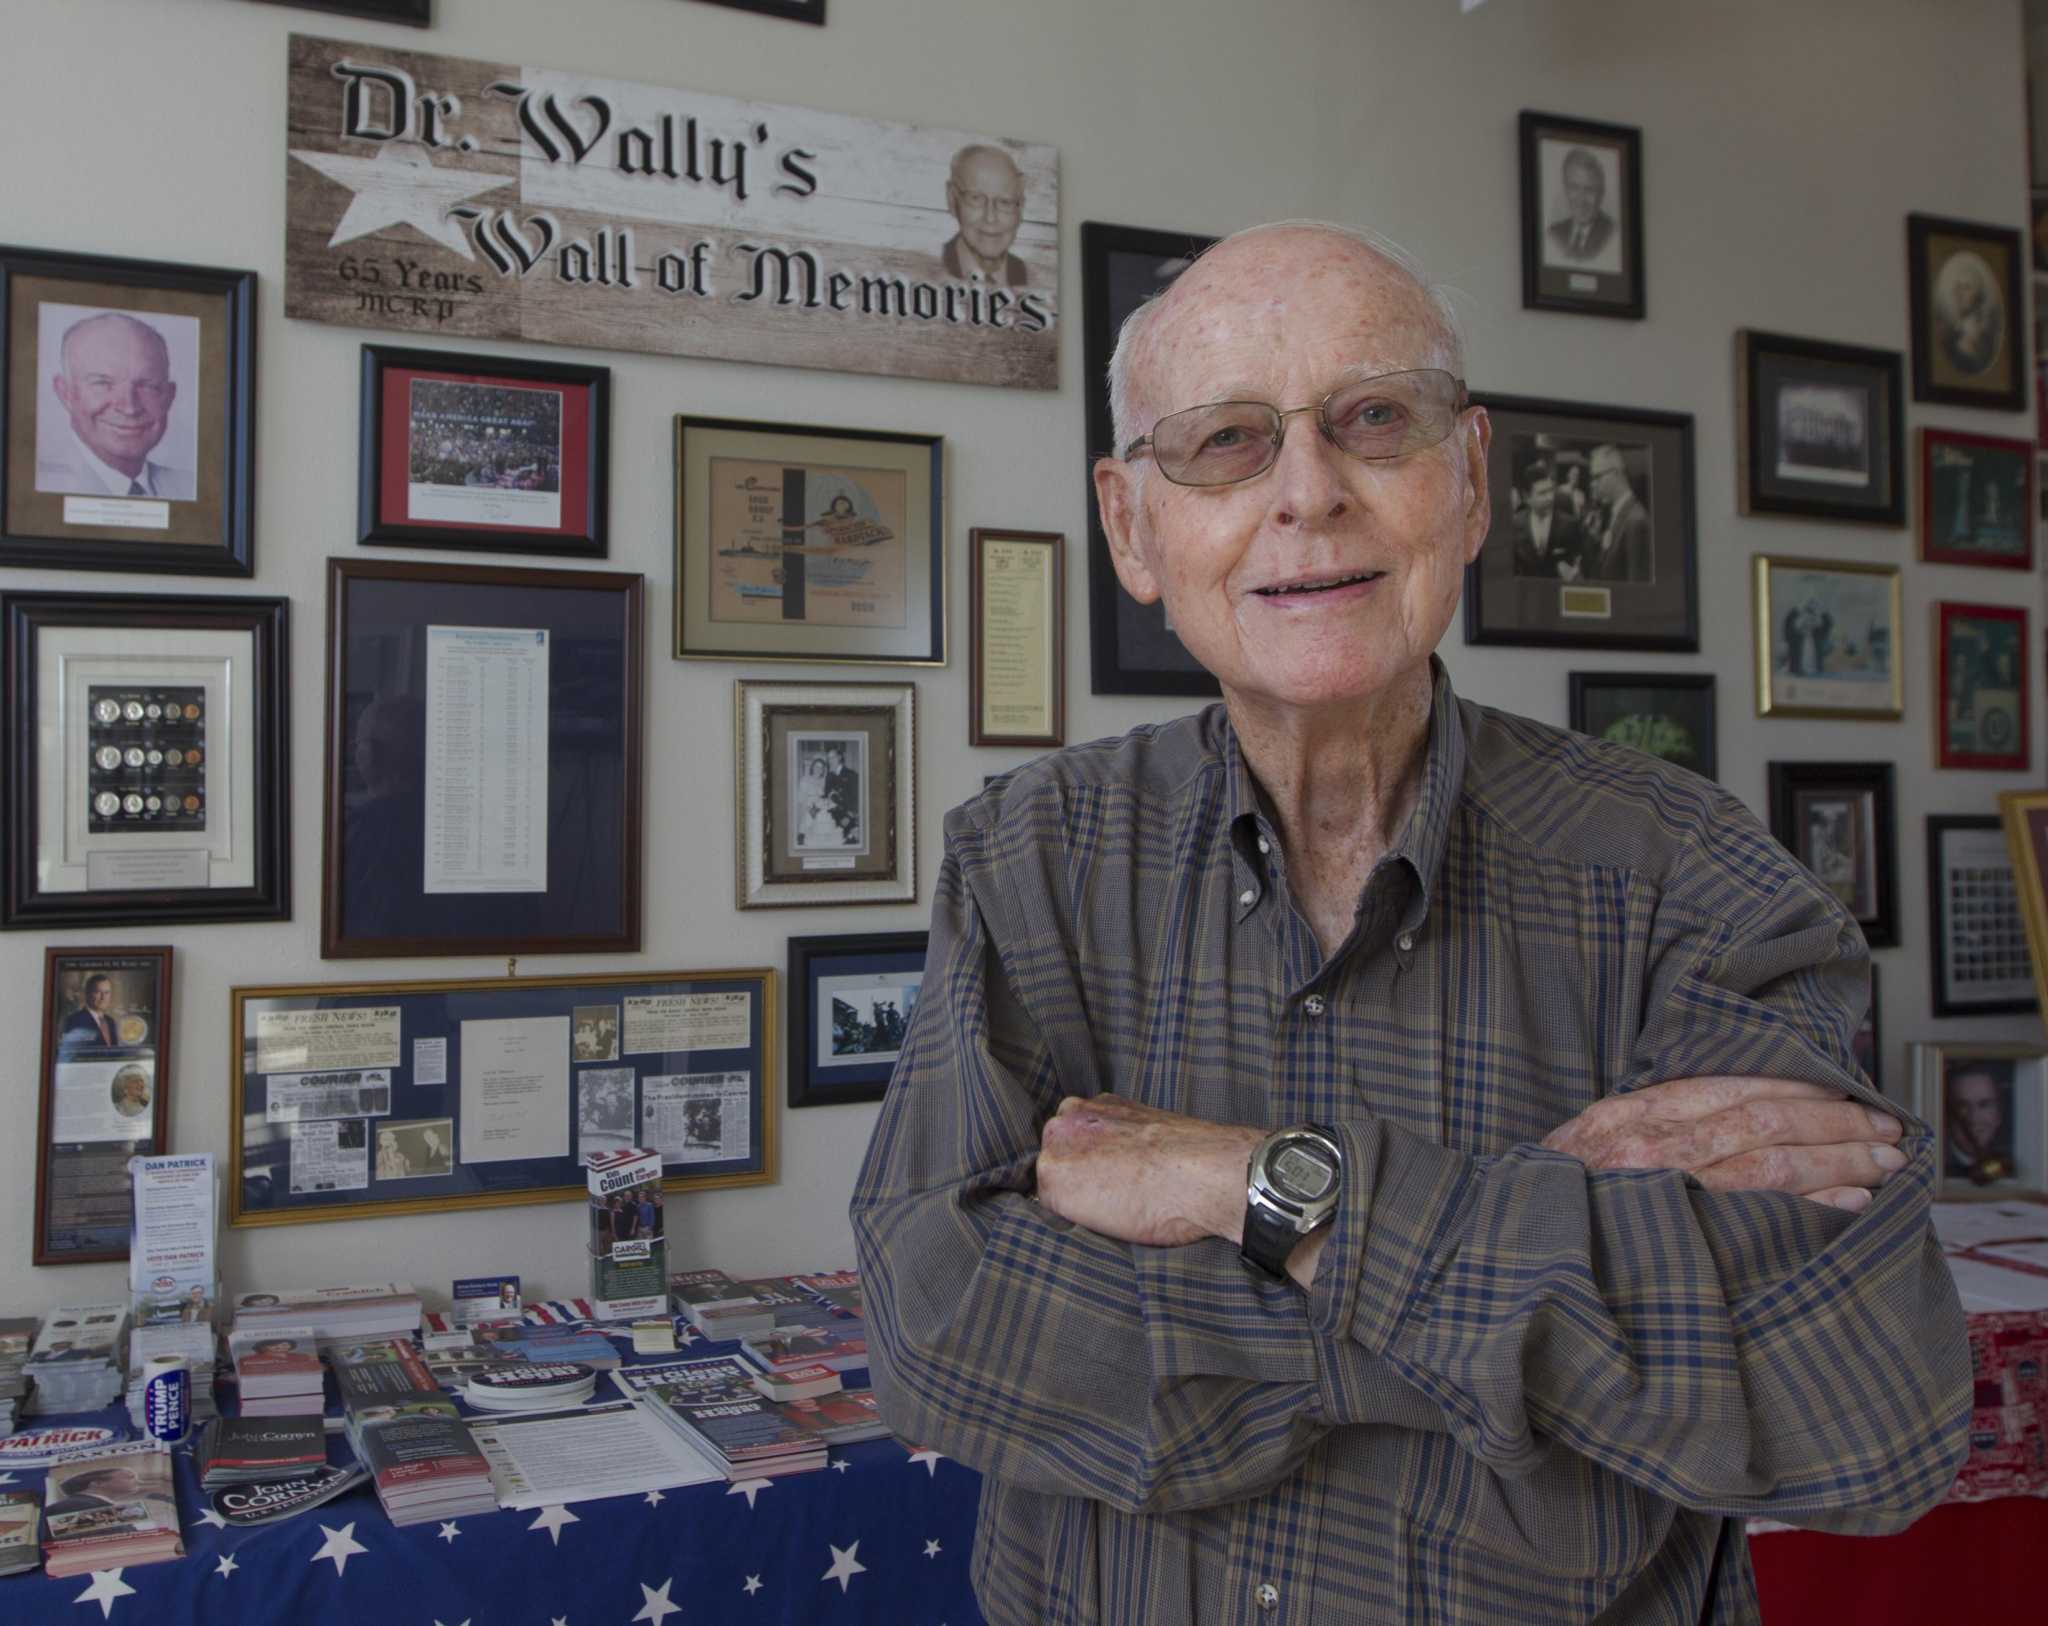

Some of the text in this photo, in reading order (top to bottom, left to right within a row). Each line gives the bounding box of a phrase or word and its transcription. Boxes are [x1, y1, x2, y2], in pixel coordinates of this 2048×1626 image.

[333, 63, 817, 201] Dr. Wally's
[338, 256, 484, 294] 65 Years
[447, 208, 1057, 332] Wall of Memories
[300, 1072, 362, 1087] COURIER
[145, 1159, 207, 1170] DAN PATRICK
[600, 1171, 635, 1192] Count
[154, 1379, 168, 1436] TRUMP
[168, 1381, 180, 1430] PENCE
[0, 1430, 104, 1449] PATRICK
[57, 1441, 157, 1463] PAXTON
[222, 1469, 349, 1510] CORNYN
[253, 1479, 308, 1496] JOHN
